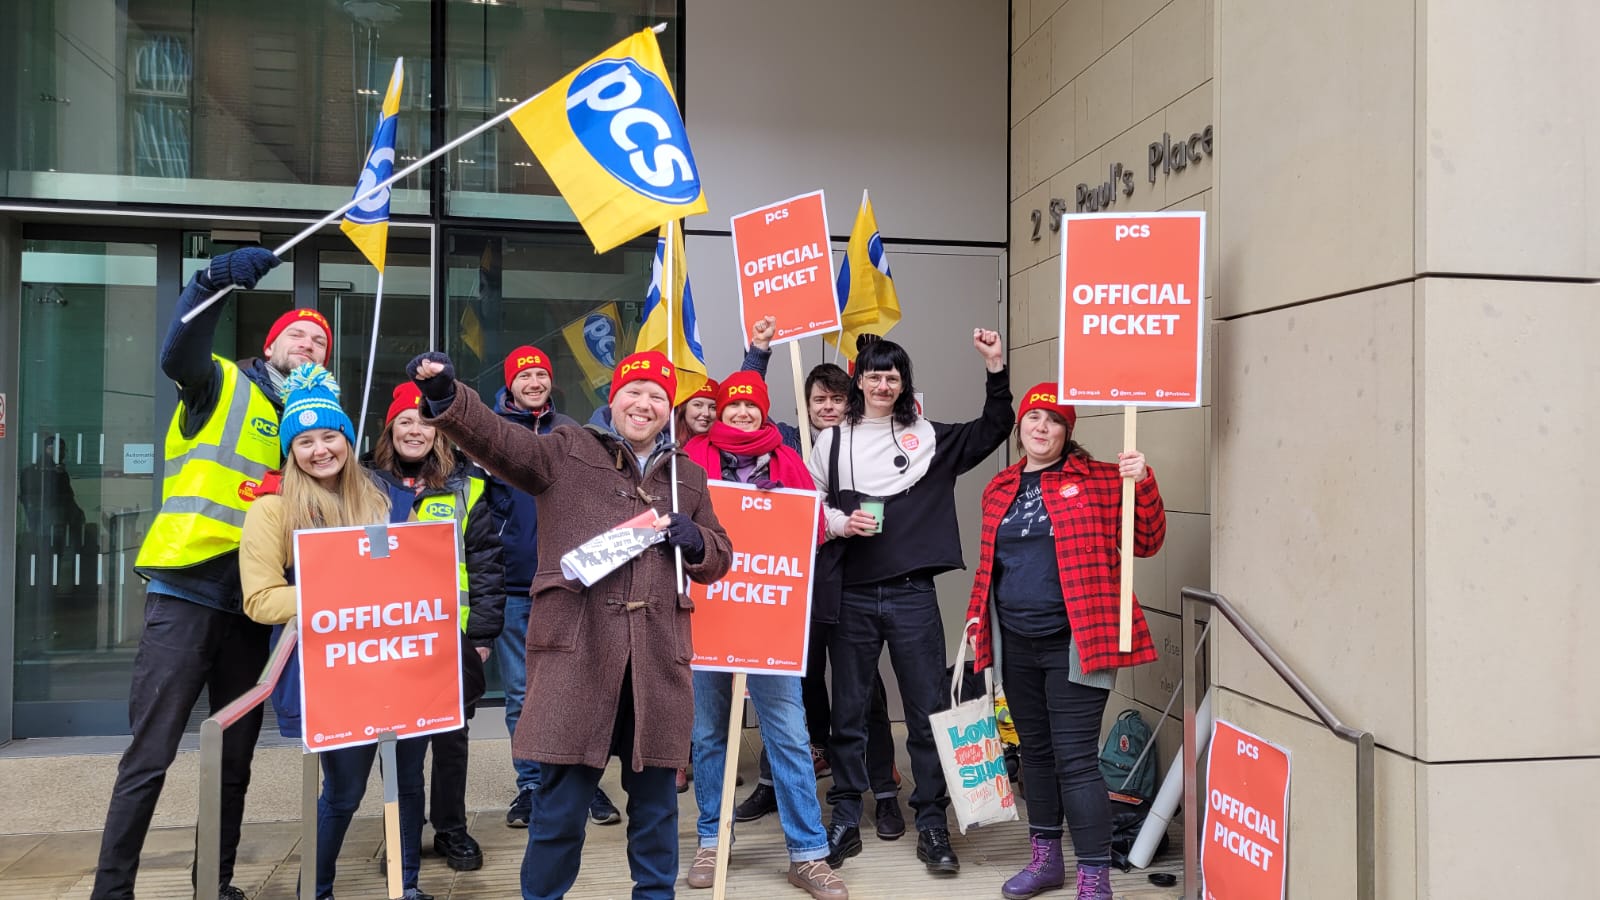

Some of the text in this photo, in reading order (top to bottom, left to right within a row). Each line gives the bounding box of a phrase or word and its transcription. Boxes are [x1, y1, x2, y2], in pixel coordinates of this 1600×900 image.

[566, 64, 694, 187] pcs
[1030, 209, 1042, 241] 2
[1075, 162, 1135, 212] Paul's
[1148, 124, 1213, 183] Place
[765, 208, 790, 225] pcs
[1115, 224, 1151, 241] pcs
[743, 242, 824, 277] OFFICIAL
[753, 265, 818, 298] PICKET
[1072, 283, 1191, 305] OFFICIAL
[1082, 314, 1180, 335] PICKET
[517, 355, 541, 369] pcs
[621, 360, 651, 379] pcs
[728, 384, 753, 398] pcs
[1029, 393, 1057, 405] pcs
[255, 418, 278, 436] pcs
[429, 505, 451, 515] pcs
[741, 495, 772, 511] pcs
[357, 535, 400, 556] ps
[731, 551, 803, 577] FICIAL
[706, 581, 793, 606] PICKET
[311, 598, 449, 634] OFFICIAL
[325, 632, 439, 668] PICKET
[947, 716, 997, 749] LOV
[1237, 738, 1259, 760] pcs
[959, 756, 1008, 788] SHO
[1211, 788, 1280, 845] OFFICIAL
[1213, 821, 1273, 872] PICKET
